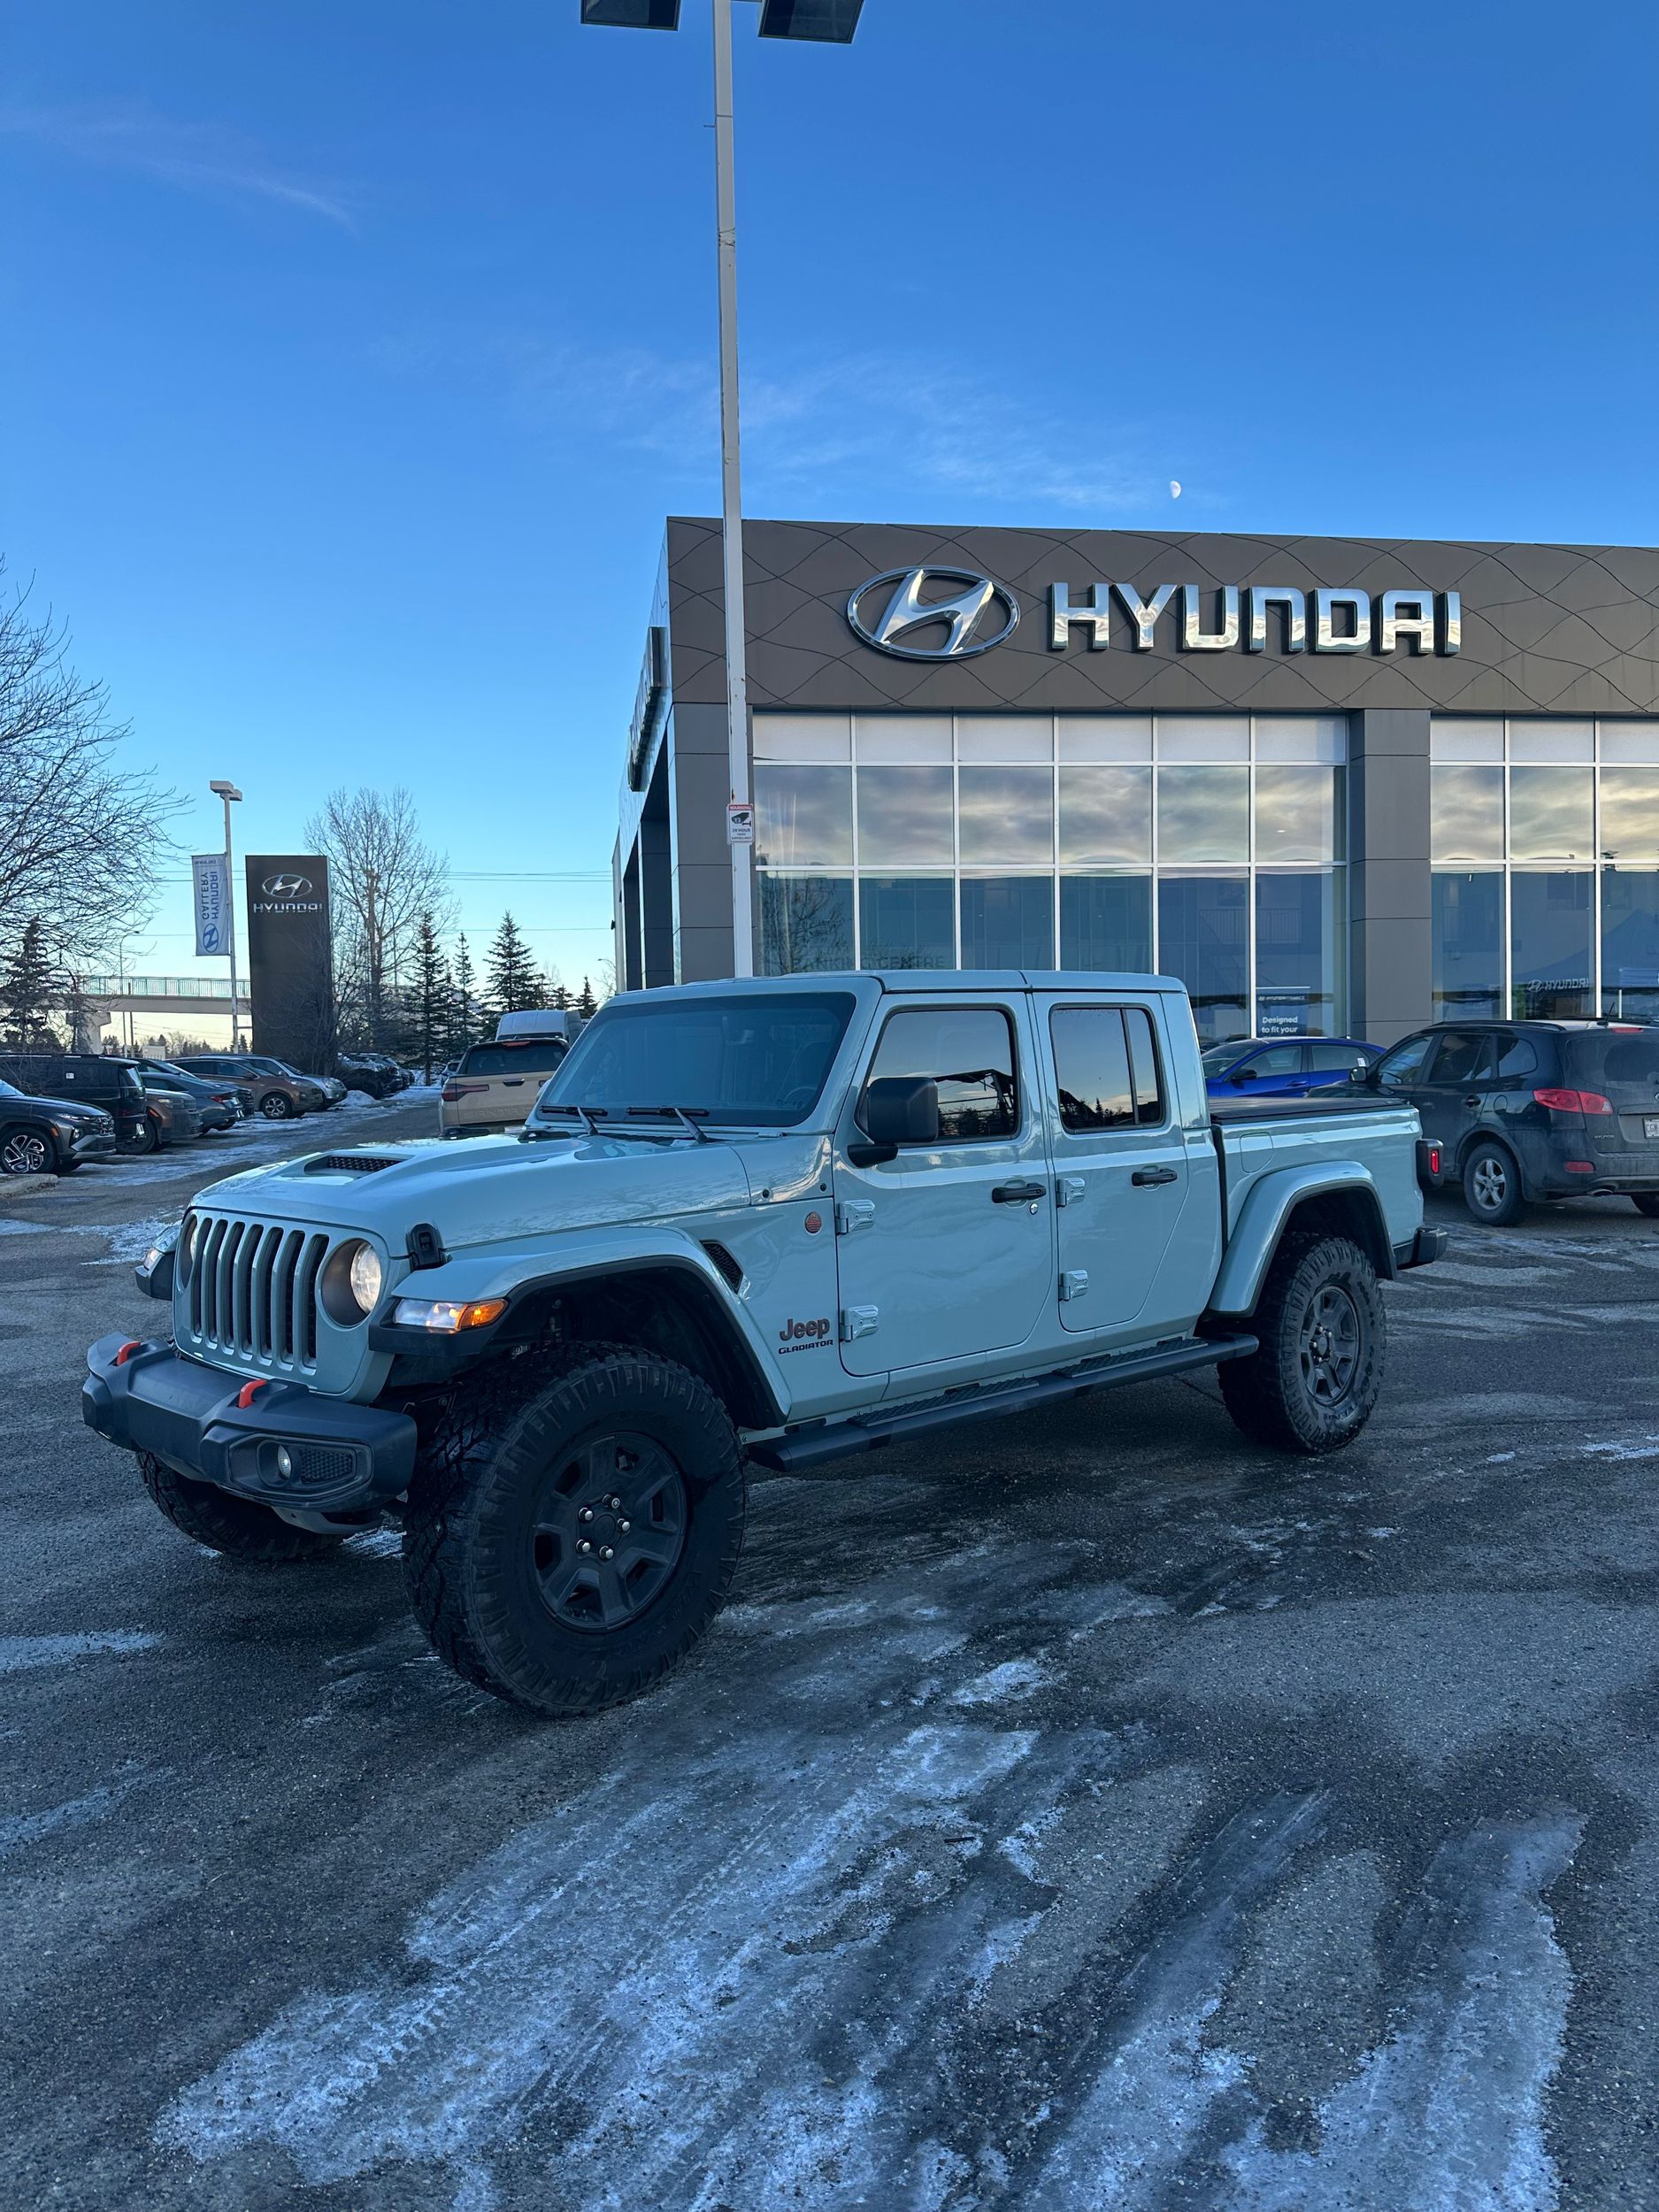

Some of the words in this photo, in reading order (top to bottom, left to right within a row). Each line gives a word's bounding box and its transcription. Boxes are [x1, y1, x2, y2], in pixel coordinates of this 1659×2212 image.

[1050, 581, 1462, 655] HYUNDAI
[253, 902, 323, 913] HYUNDAI
[1262, 1016, 1298, 1025] Designed
[780, 1318, 830, 1341] Jeep
[779, 1339, 833, 1354] GLADIATOR
